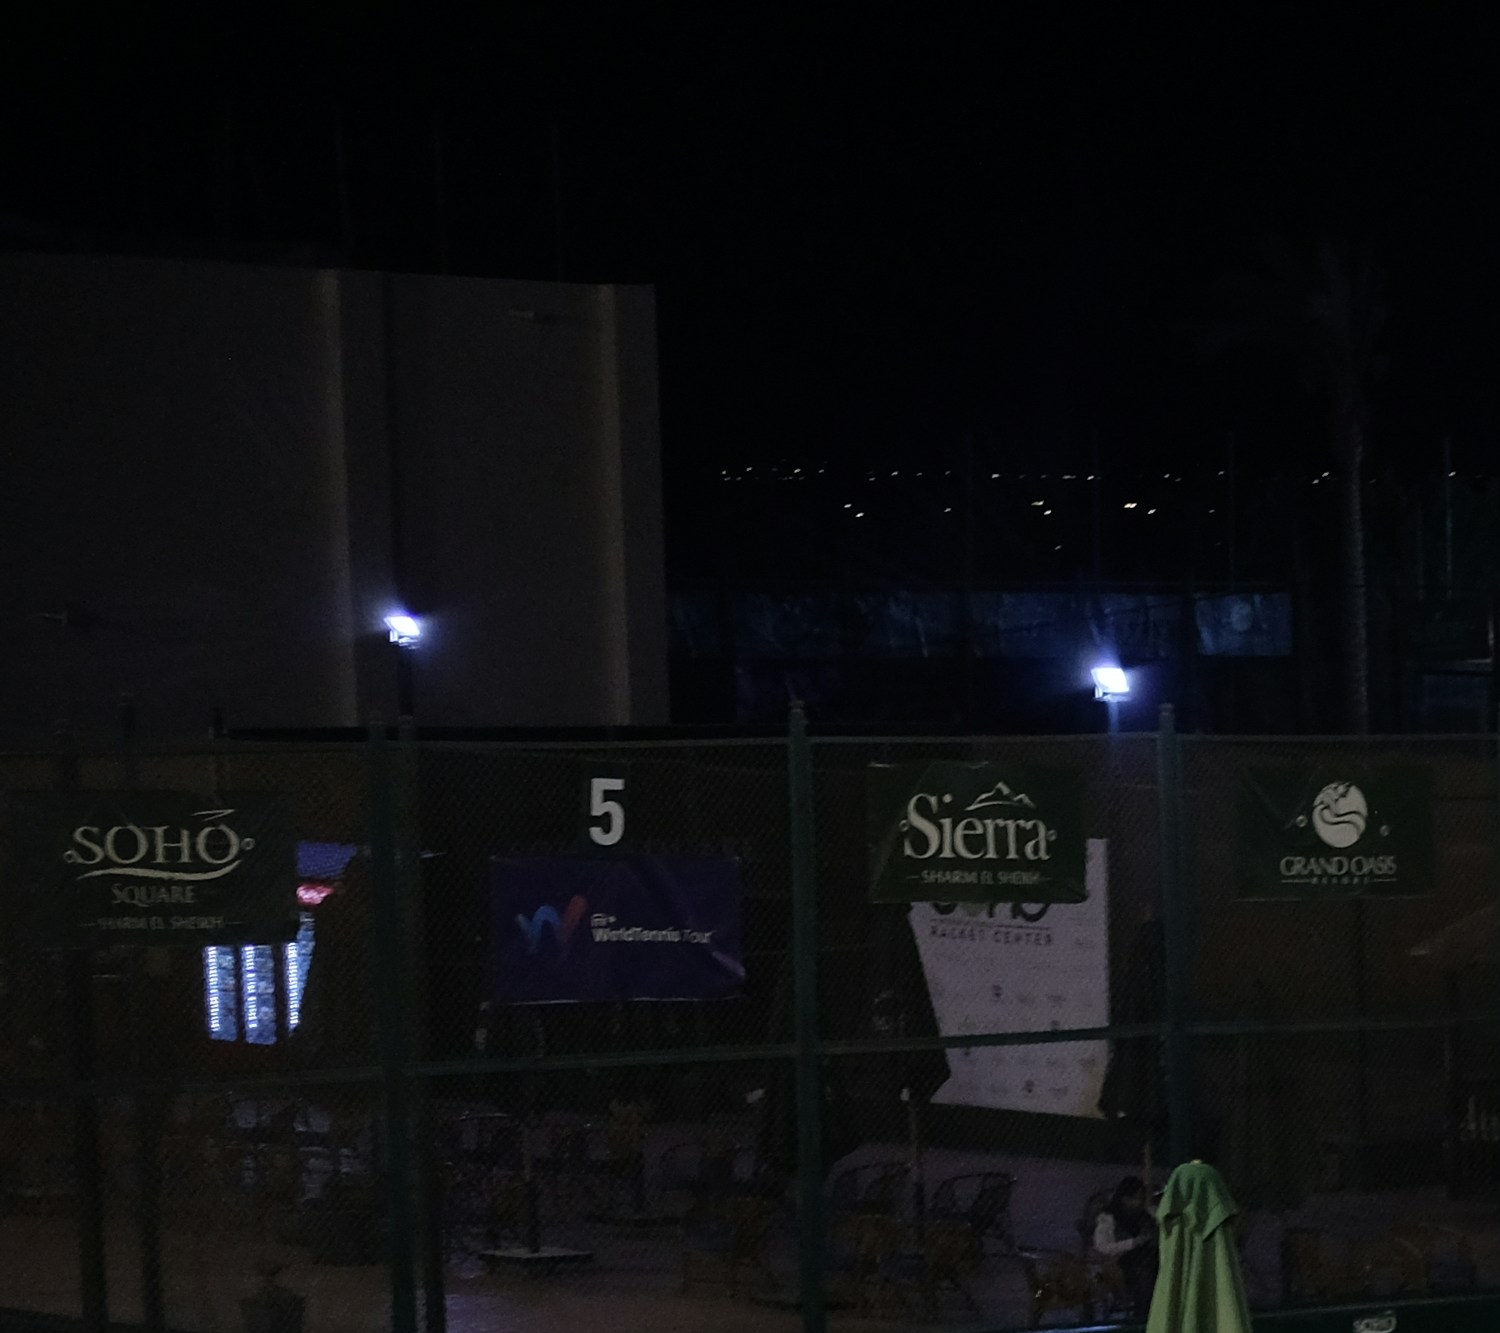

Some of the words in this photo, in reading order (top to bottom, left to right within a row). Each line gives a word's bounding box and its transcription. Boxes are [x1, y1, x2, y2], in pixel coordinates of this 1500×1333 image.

[589, 777, 626, 846] 5
[903, 793, 1052, 861] Sierra
[64, 823, 241, 865] SOHO
[1279, 856, 1350, 876] GRAND
[1350, 855, 1398, 875] OASIS
[111, 882, 198, 908] SQUARE
